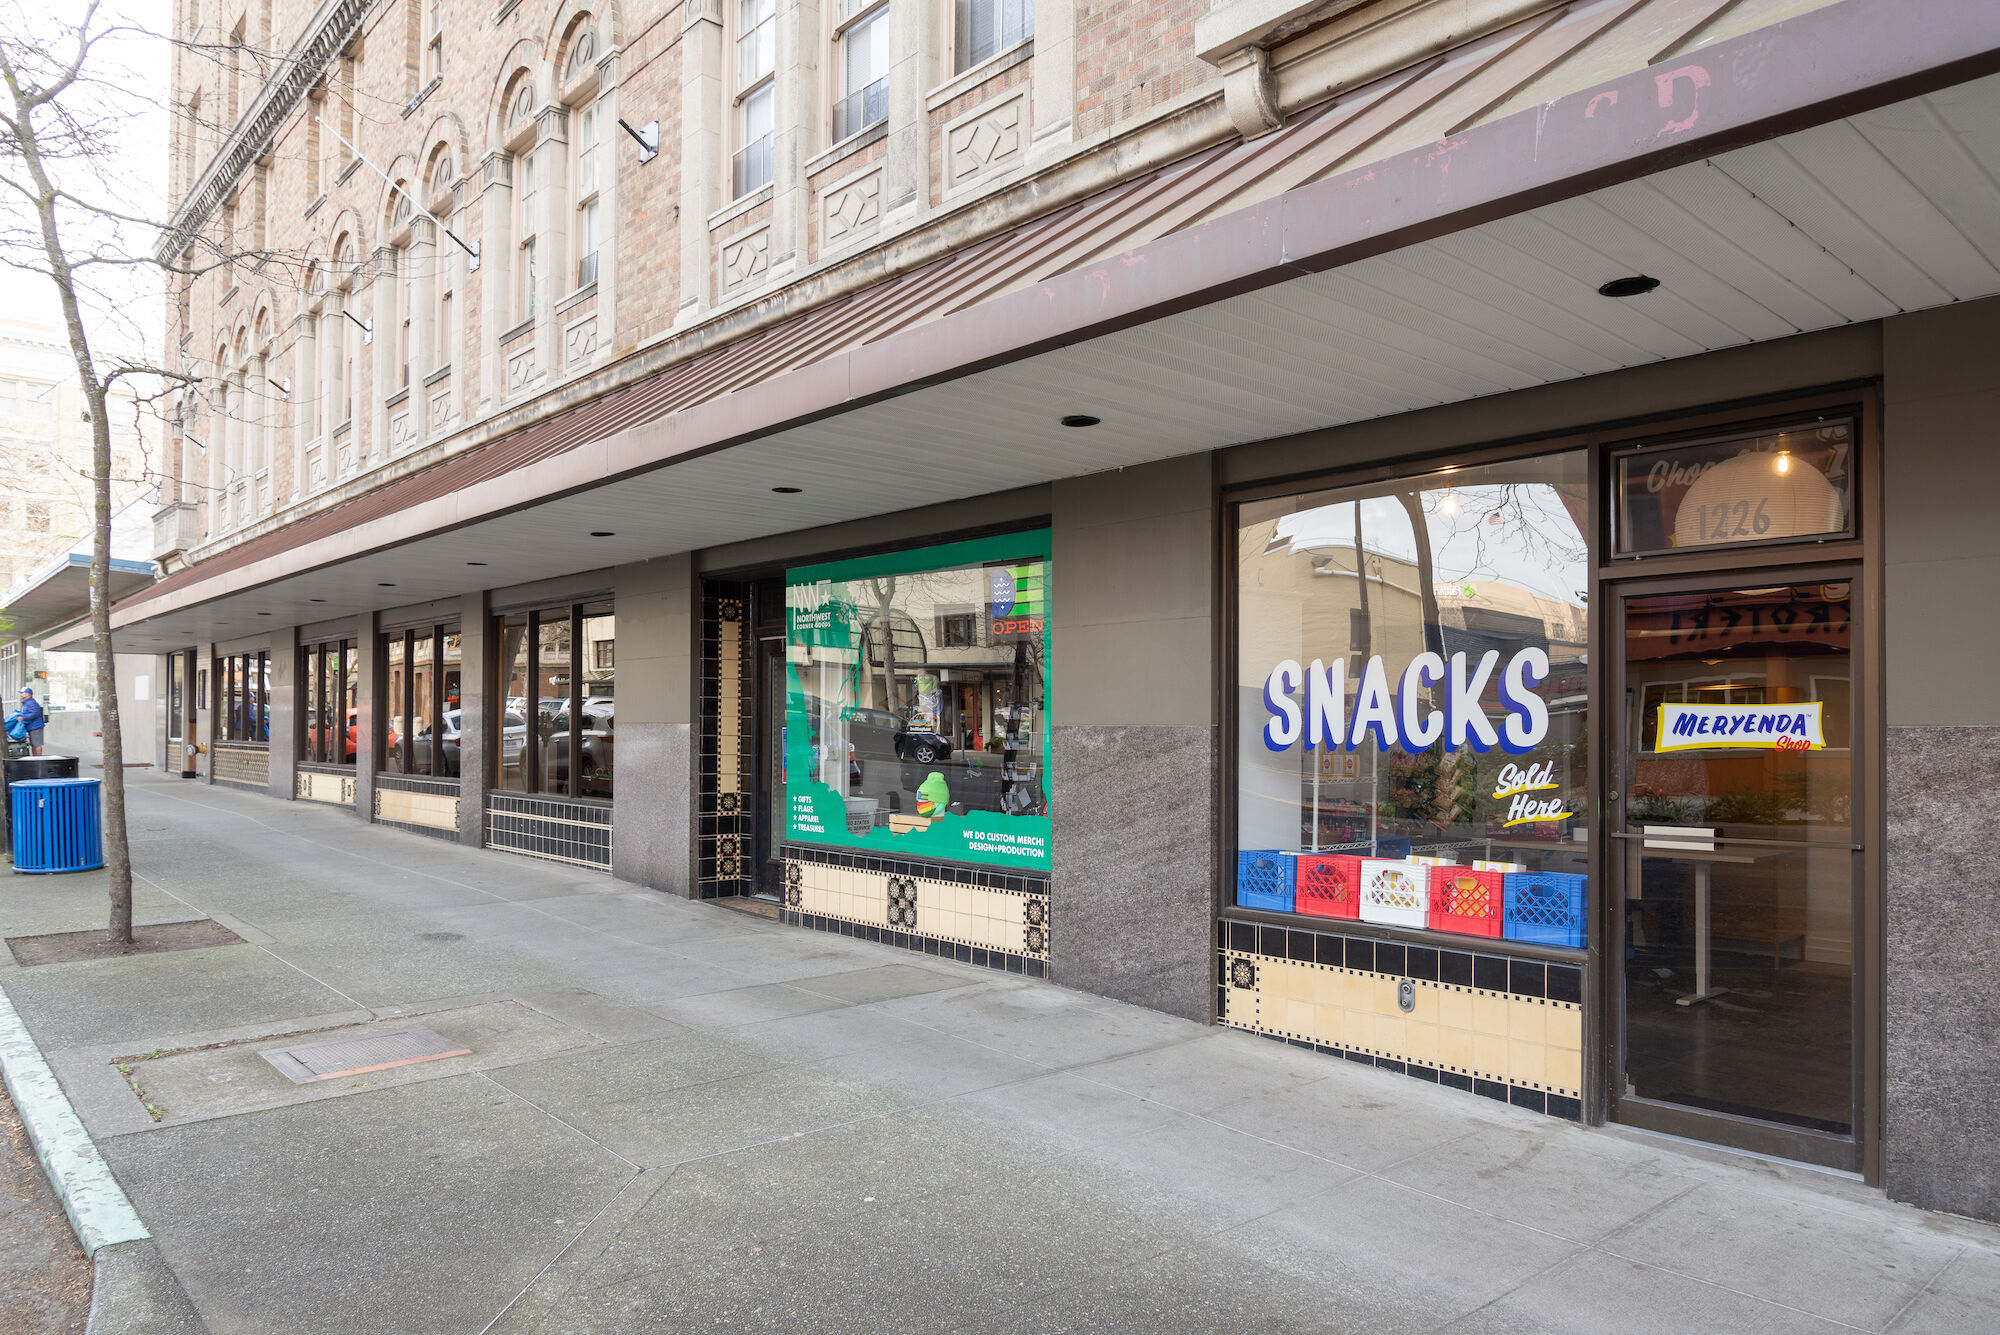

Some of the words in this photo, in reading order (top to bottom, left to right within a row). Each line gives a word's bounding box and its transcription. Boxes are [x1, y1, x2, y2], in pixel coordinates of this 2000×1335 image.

[1696, 498, 1770, 539] 1226
[797, 613, 831, 623] NORTHWEST
[992, 619, 1044, 635] OPEN
[1264, 647, 1551, 752] SNACKS
[1672, 712, 1806, 737] MERYENDA
[1775, 735, 1811, 754] Shop
[1496, 760, 1554, 794] Sold
[798, 805, 813, 813] FLAGS
[1507, 794, 1564, 821] Here
[798, 814, 820, 823] APPAREL
[798, 824, 825, 833] TREASURES
[963, 830, 973, 839] WE
[975, 831, 985, 840] DO
[987, 832, 1015, 843] CUSTOM
[1017, 835, 1044, 846] MERCH!
[969, 842, 1044, 857] DESIGN+PRODUCTION
